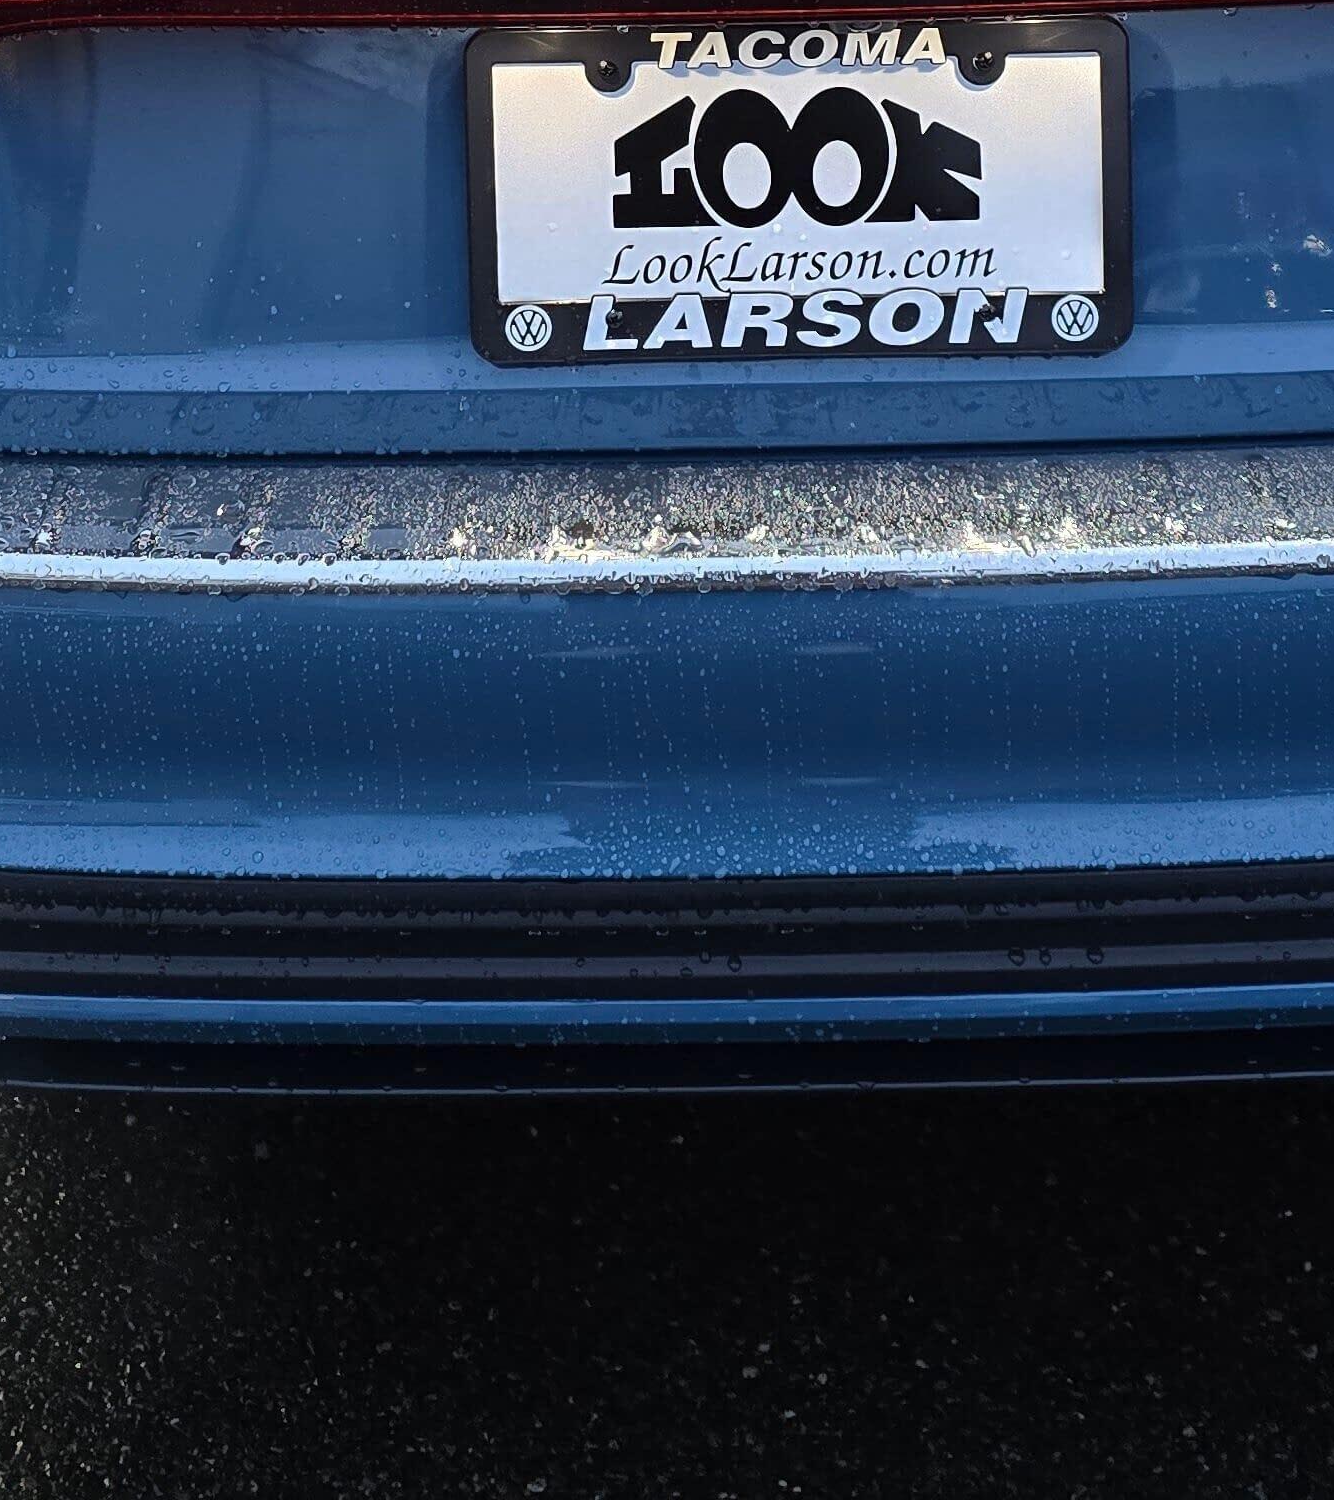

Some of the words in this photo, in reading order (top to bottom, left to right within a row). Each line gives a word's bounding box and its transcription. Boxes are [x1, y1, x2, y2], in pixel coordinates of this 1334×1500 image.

[649, 26, 948, 70] TACOMA
[612, 86, 983, 229] LOOK
[601, 235, 998, 291] LookLarson.com
[582, 288, 1029, 352] LARSON
